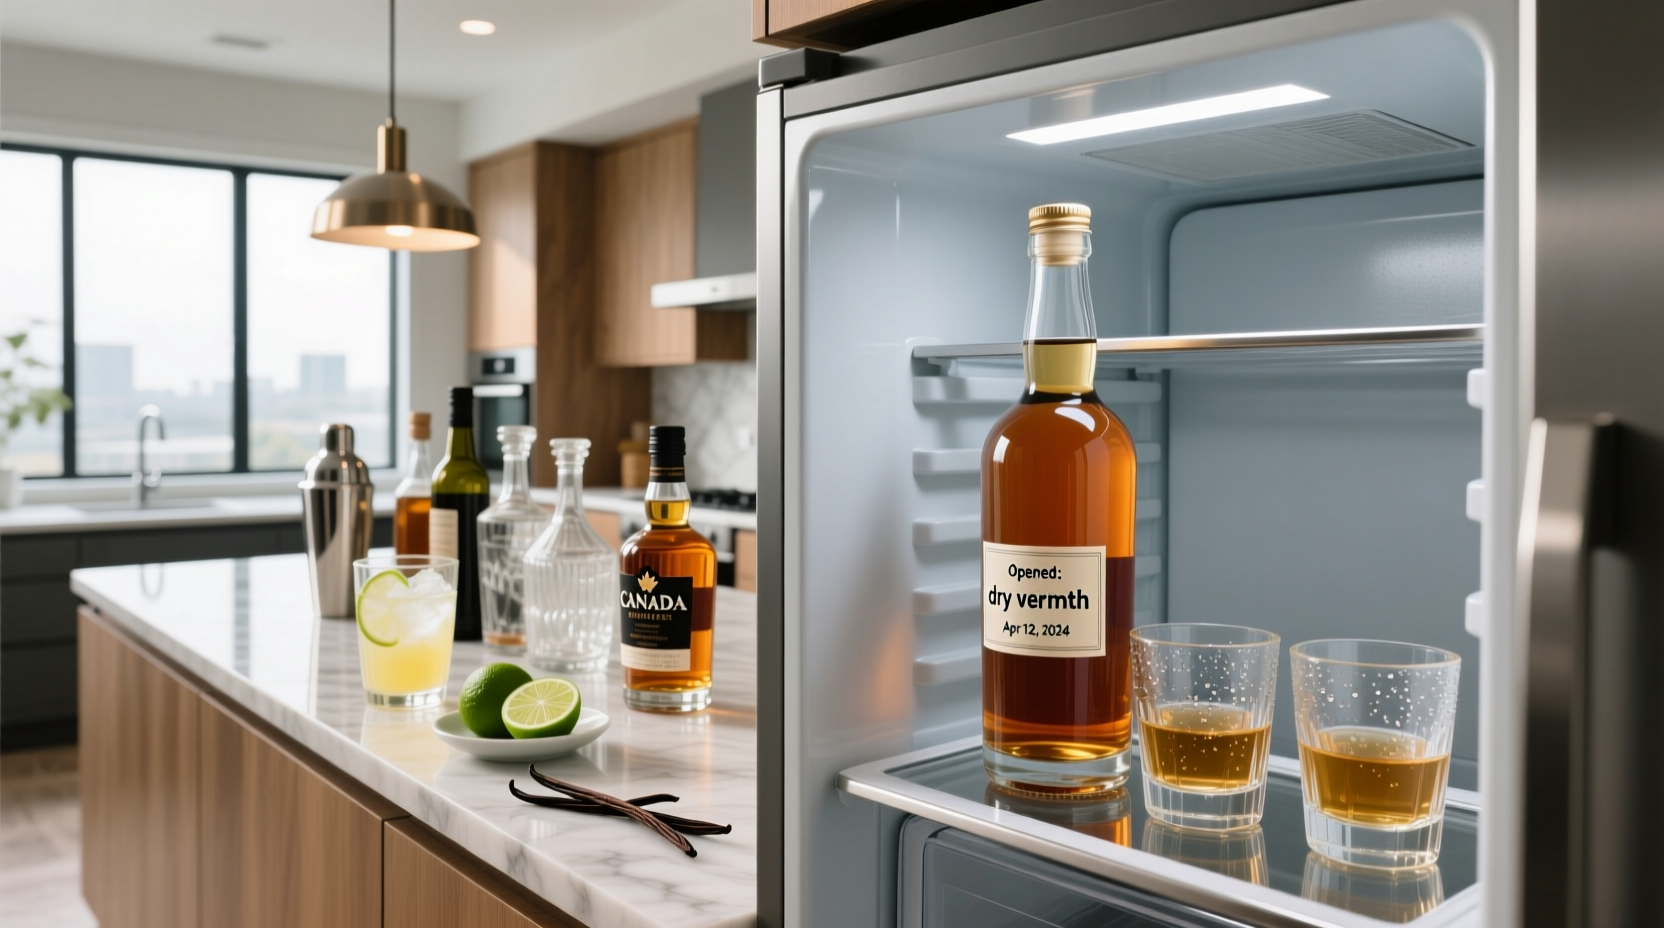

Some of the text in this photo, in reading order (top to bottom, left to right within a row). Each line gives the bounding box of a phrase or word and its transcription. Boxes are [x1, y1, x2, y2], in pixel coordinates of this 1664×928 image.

[1008, 563, 1062, 582] Opened:
[620, 590, 688, 611] CANADA
[988, 584, 1090, 612] dry vermth
[1002, 620, 1071, 638] Apr 12, 2024
